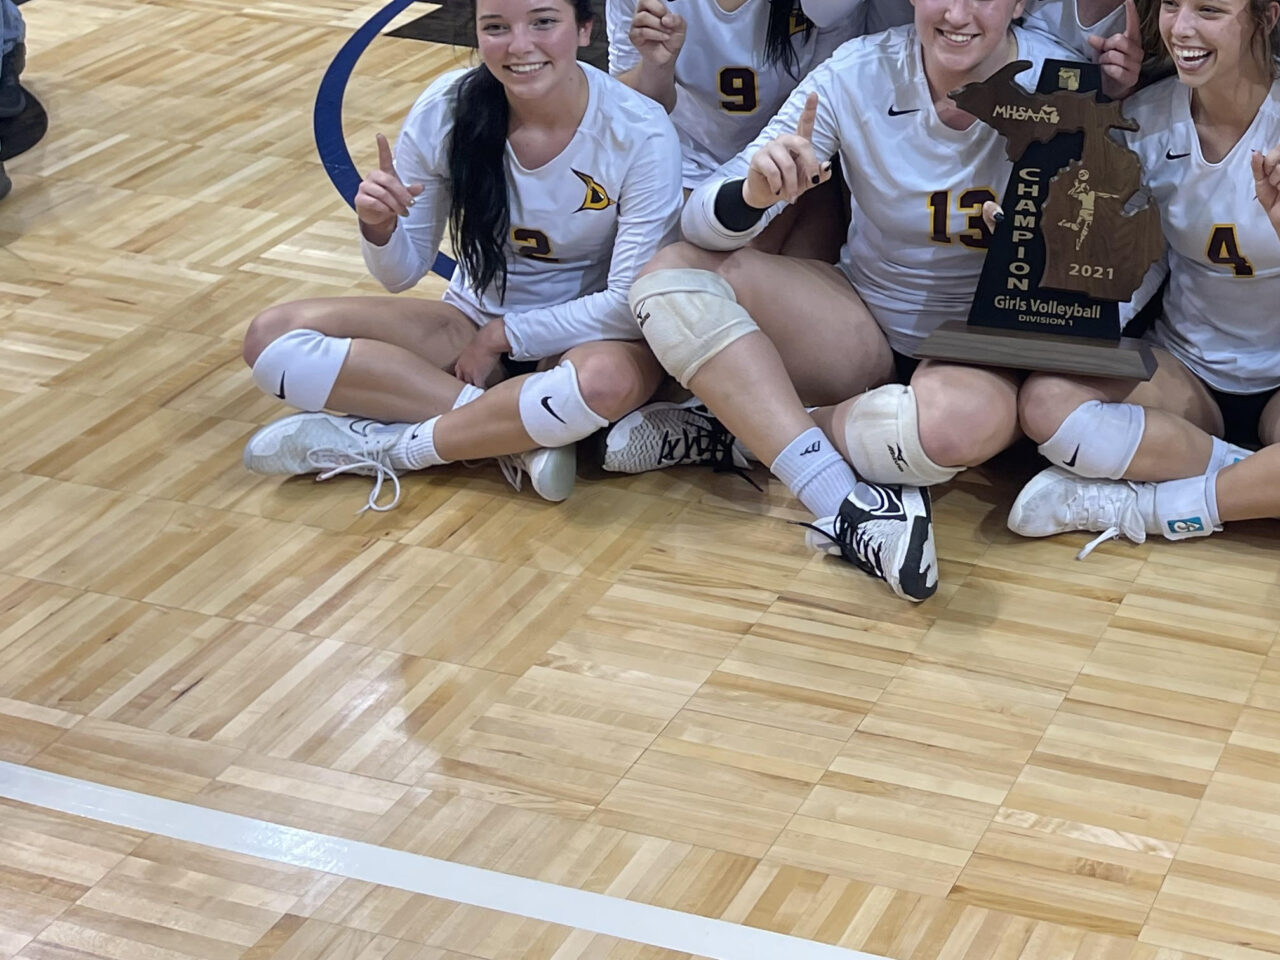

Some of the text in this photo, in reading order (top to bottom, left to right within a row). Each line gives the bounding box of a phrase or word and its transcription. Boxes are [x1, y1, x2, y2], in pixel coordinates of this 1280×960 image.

[716, 66, 759, 115] 9
[993, 104, 1052, 124] MHSAA
[927, 186, 997, 251] 13
[1006, 167, 1041, 291] CHAMPION
[1204, 223, 1256, 279] 4
[1069, 263, 1115, 281] 2021
[994, 294, 1101, 320] Girls Volleyball
[1018, 314, 1074, 328] DIVISION 1
